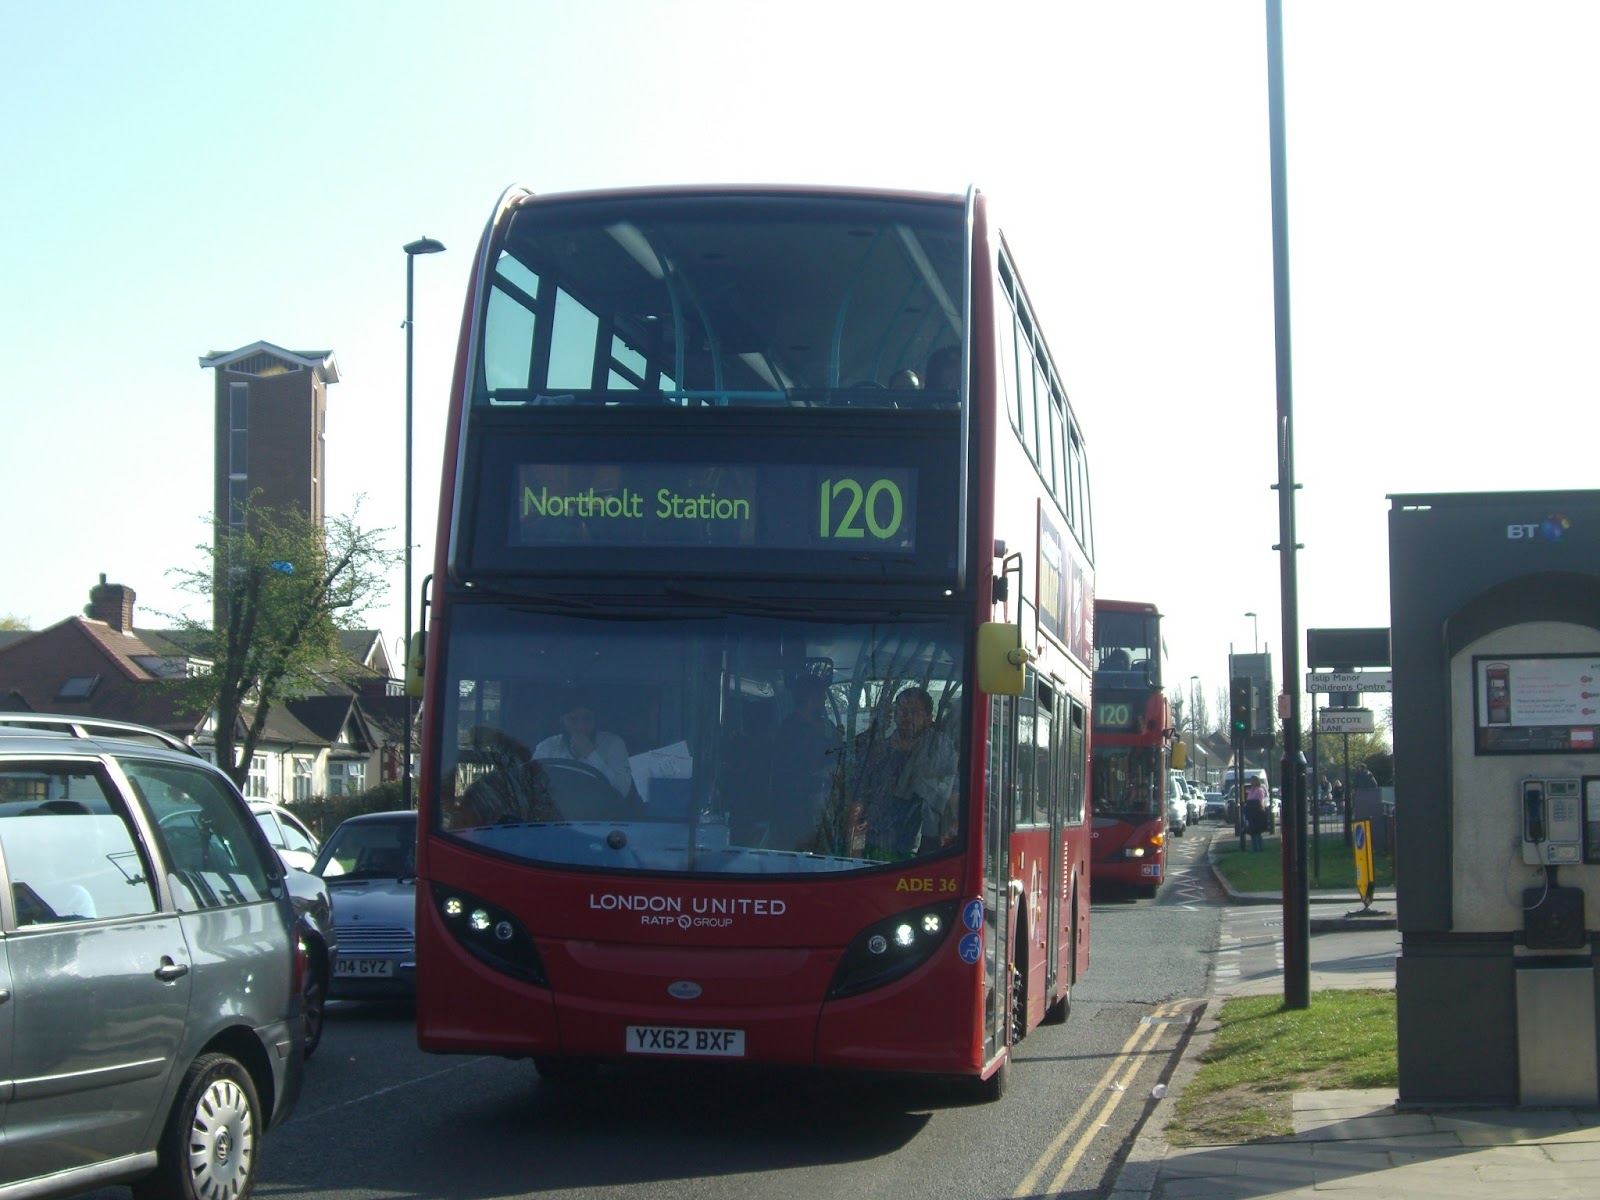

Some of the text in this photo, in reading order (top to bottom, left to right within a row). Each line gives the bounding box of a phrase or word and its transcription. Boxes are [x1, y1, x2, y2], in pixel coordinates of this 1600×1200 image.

[524, 478, 903, 539] Northolt Station 120
[1507, 524, 1539, 539] BT
[1100, 703, 1129, 725] 120
[896, 878, 957, 892] ADE 36
[590, 894, 786, 916] LONDON UNITED
[641, 916, 733, 928] RATP GROUP
[359, 960, 386, 973] GYZ
[635, 1027, 737, 1052] YX62 BXF
